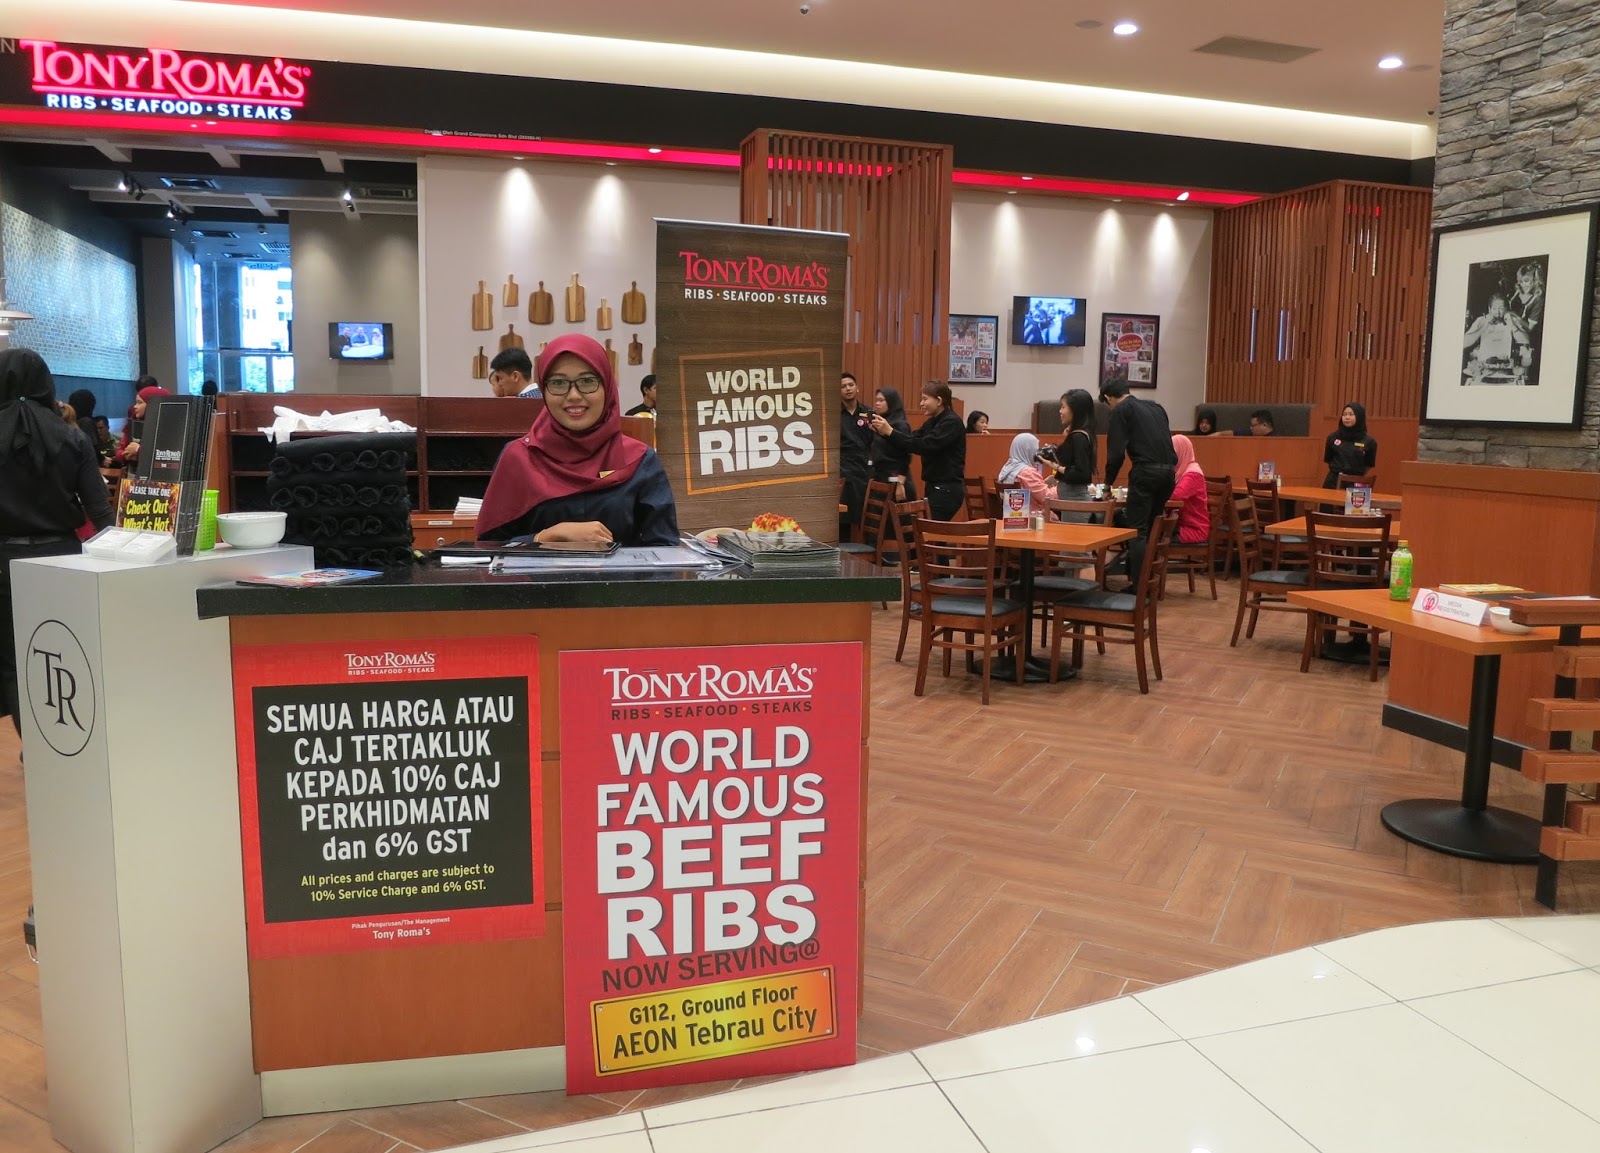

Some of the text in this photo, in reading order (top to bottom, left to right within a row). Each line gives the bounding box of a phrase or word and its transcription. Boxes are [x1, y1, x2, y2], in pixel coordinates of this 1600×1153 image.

[20, 39, 306, 99] TONY ROMA'S
[46, 93, 293, 121] RIBS SEAFOOD STEAKS
[679, 251, 829, 290] TONY ROMA'S
[684, 288, 827, 306] RIBS SEAFOOD STEAKS
[706, 366, 801, 394] WORLD
[697, 392, 813, 426] FAMOUS
[698, 421, 815, 476] RIBS
[126, 499, 169, 515] Check Out
[129, 485, 171, 498] PLEASE TAKE ONE
[123, 515, 170, 531] What's Hot
[344, 651, 435, 668] TONY ROMA'S
[603, 662, 814, 701] TONY ROMA'S
[266, 695, 514, 733] SEMUA HARGA ATAU
[612, 701, 812, 721] RIBS SEAFOOD STEAKS
[294, 729, 492, 765] CAJ TERTAKLUK
[612, 725, 810, 776] WORLD
[286, 761, 501, 799] KEPADA 10% CAJ
[301, 794, 490, 831] PERKHIDMATAN
[597, 772, 825, 827] FAMOUS
[322, 828, 472, 861] dan 6% GST
[597, 818, 826, 894] BEEF
[301, 863, 495, 888] All prices and charges are subject to
[311, 879, 486, 901] 10% Service Charge and 6% GST.
[373, 927, 431, 940] Tony Roma's
[415, 916, 450, 924] Management
[607, 884, 817, 960] RIBS
[602, 961, 670, 992] NOW
[629, 986, 798, 1025] G112, Ground Floor
[613, 1005, 818, 1059] AEON Tebrau City
